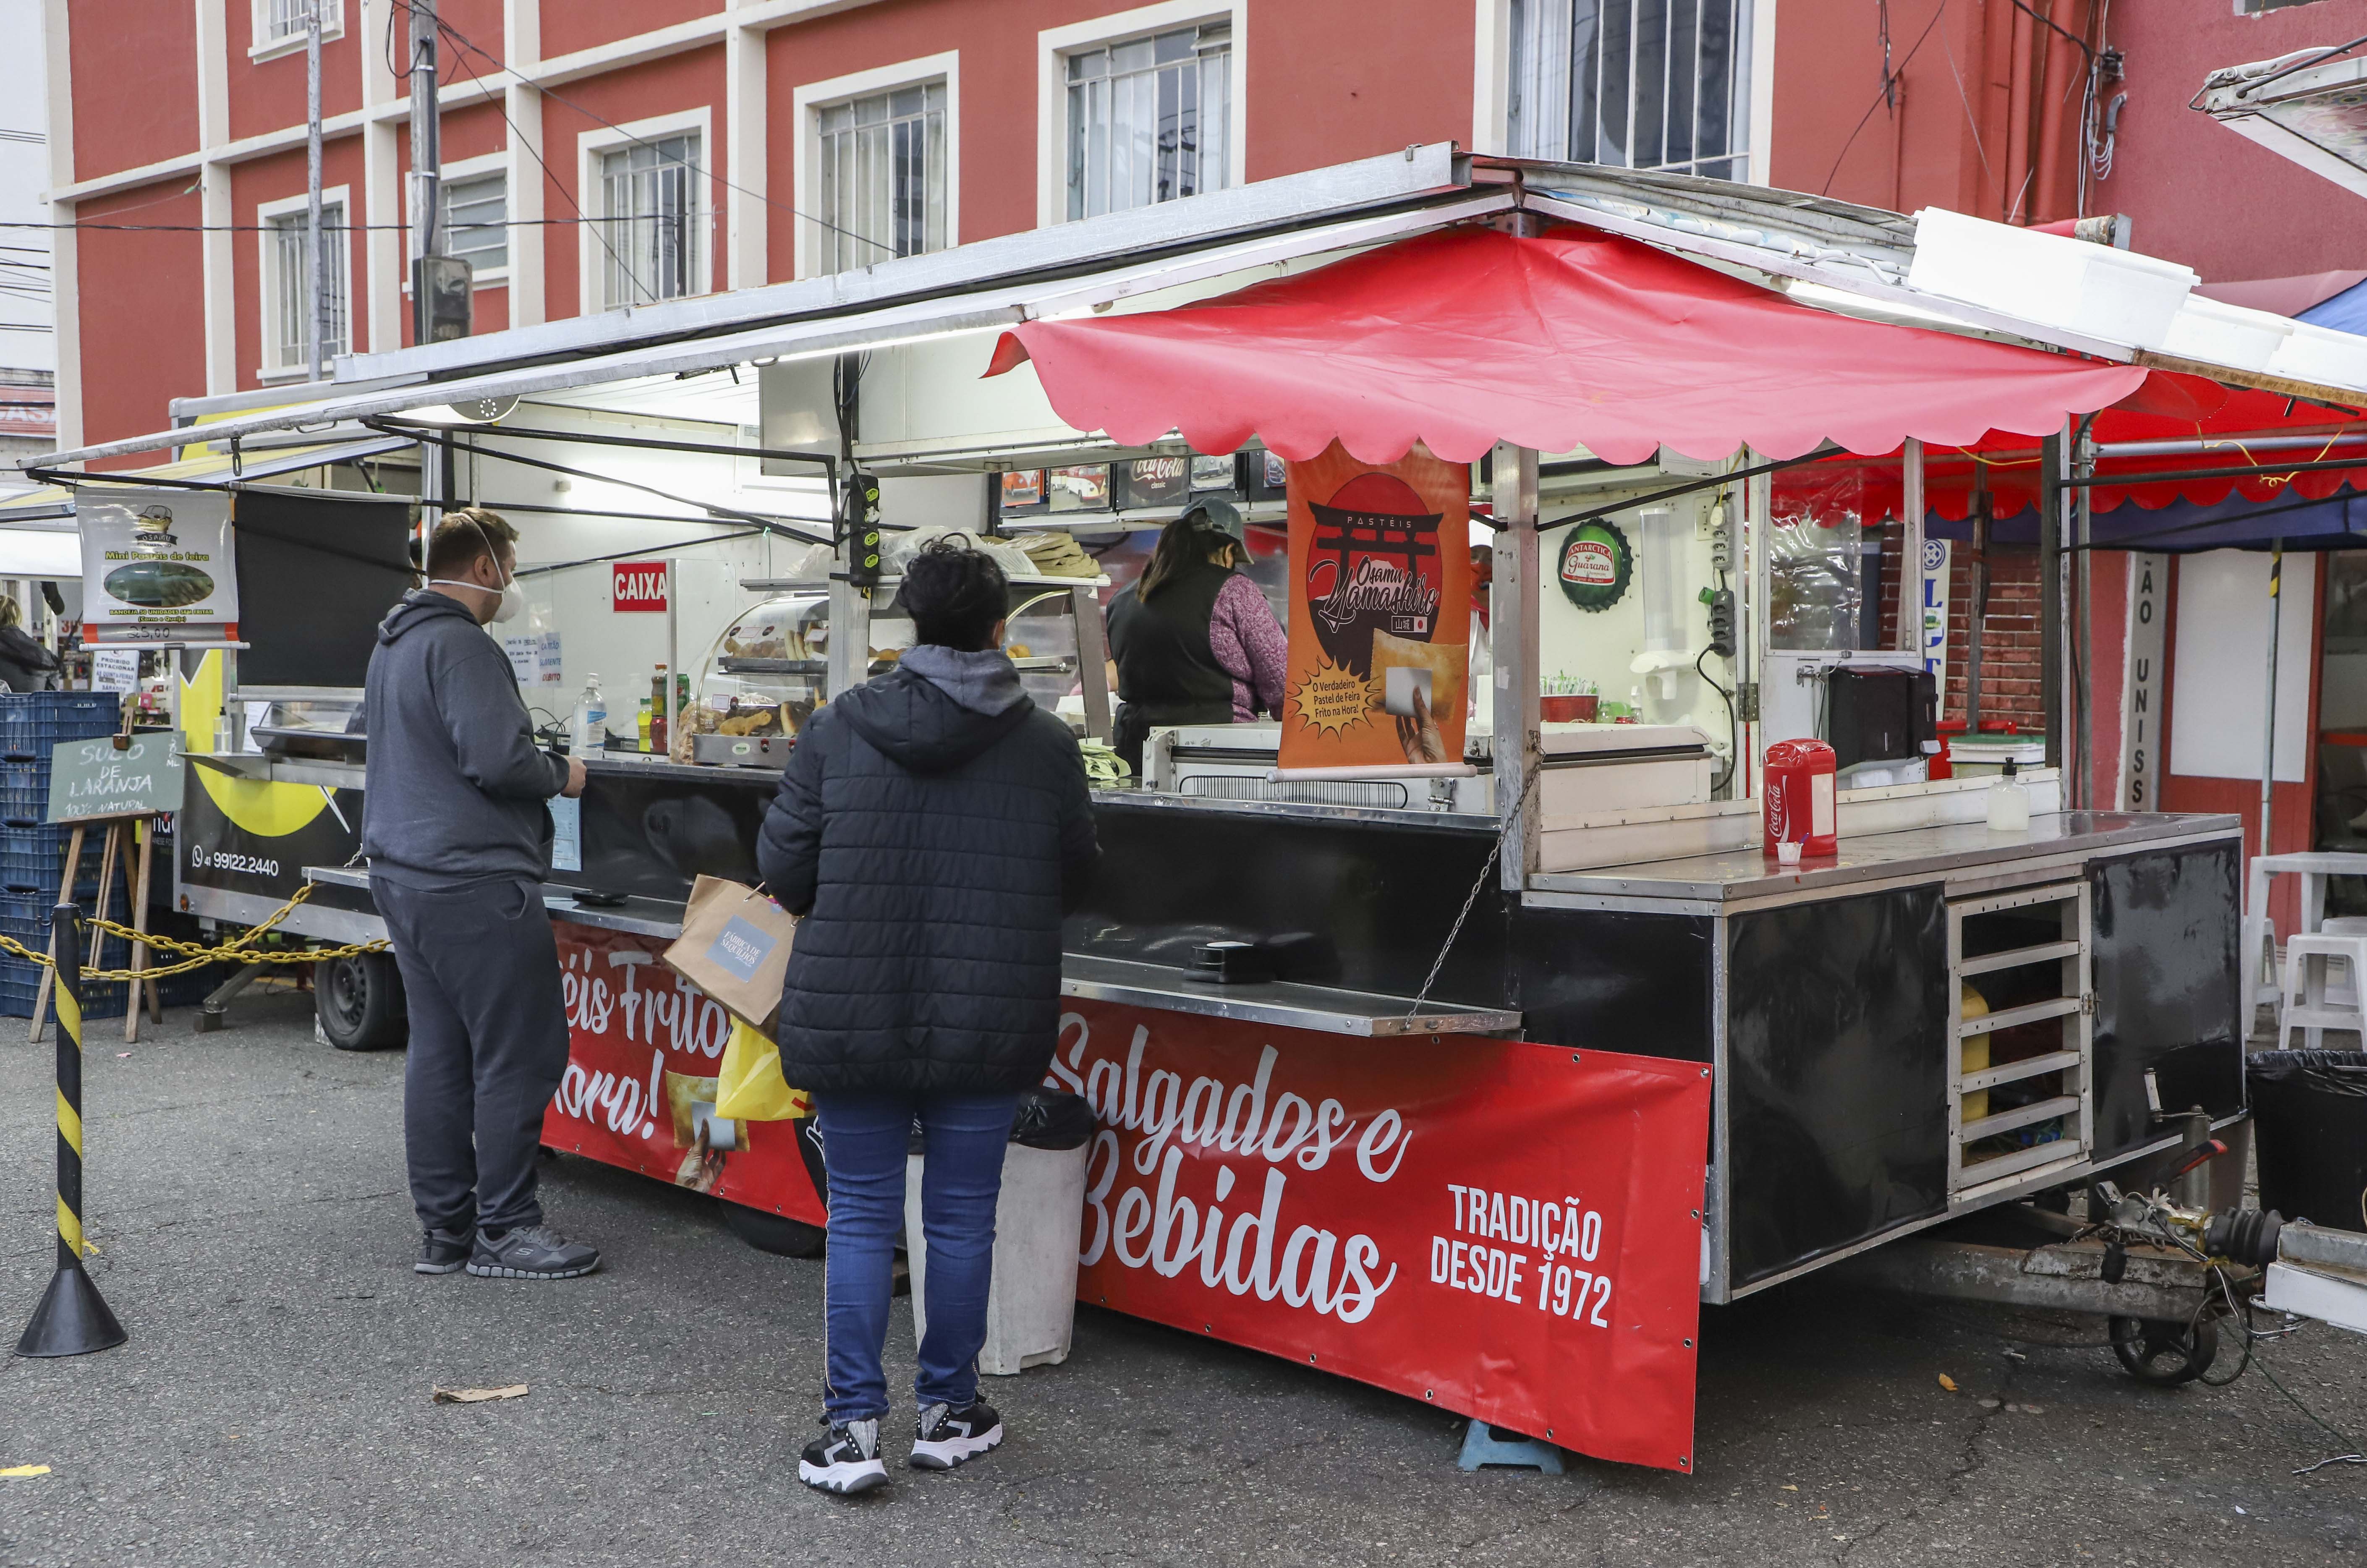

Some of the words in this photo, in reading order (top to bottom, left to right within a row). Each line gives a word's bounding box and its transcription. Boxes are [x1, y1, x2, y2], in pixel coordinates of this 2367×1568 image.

[1347, 517, 1411, 528] PASTÉIS
[105, 551, 128, 560] Mini
[131, 551, 168, 561] Pastéis
[170, 551, 184, 561] de
[185, 552, 209, 561] feira
[1569, 544, 1611, 559] ANTARCTICA
[1356, 555, 1405, 586] Osamu
[1568, 555, 1609, 574] Guaraná
[615, 572, 667, 600] CAIXA
[1309, 559, 1439, 633] Yamashiro
[127, 626, 170, 640] 25,00
[1396, 618, 1410, 630] 山城
[96, 663, 134, 671] ESTACIONAR
[1313, 682, 1318, 692] O
[1320, 679, 1355, 692] Verdadeiro
[1314, 693, 1334, 705] Pastel
[1336, 693, 1343, 703] de
[1345, 692, 1360, 702] Feira
[1315, 708, 1331, 718] Frito
[1342, 704, 1359, 715] Hora!
[2132, 659, 2150, 812] UNISS
[79, 744, 144, 765] SUCO
[167, 759, 180, 768] ML
[100, 765, 122, 778] DE
[69, 774, 152, 797] LARANJA
[65, 802, 92, 818] 100%
[98, 800, 147, 813] NATURAL
[204, 857, 211, 866] 41
[213, 852, 279, 877] 99122.2440
[720, 938, 757, 964] SEQUILHOS
[724, 931, 751, 951] FÁBRICA
[749, 946, 761, 957] DE
[558, 947, 615, 1034] éis
[1043, 1012, 1357, 1175] Salgados
[1356, 1109, 1412, 1182] e
[1078, 1129, 1398, 1323] Bebidas
[1447, 1184, 1602, 1262] TRADIÇÃO
[1430, 1236, 1527, 1304] DESDE
[1538, 1262, 1611, 1328] 1972
